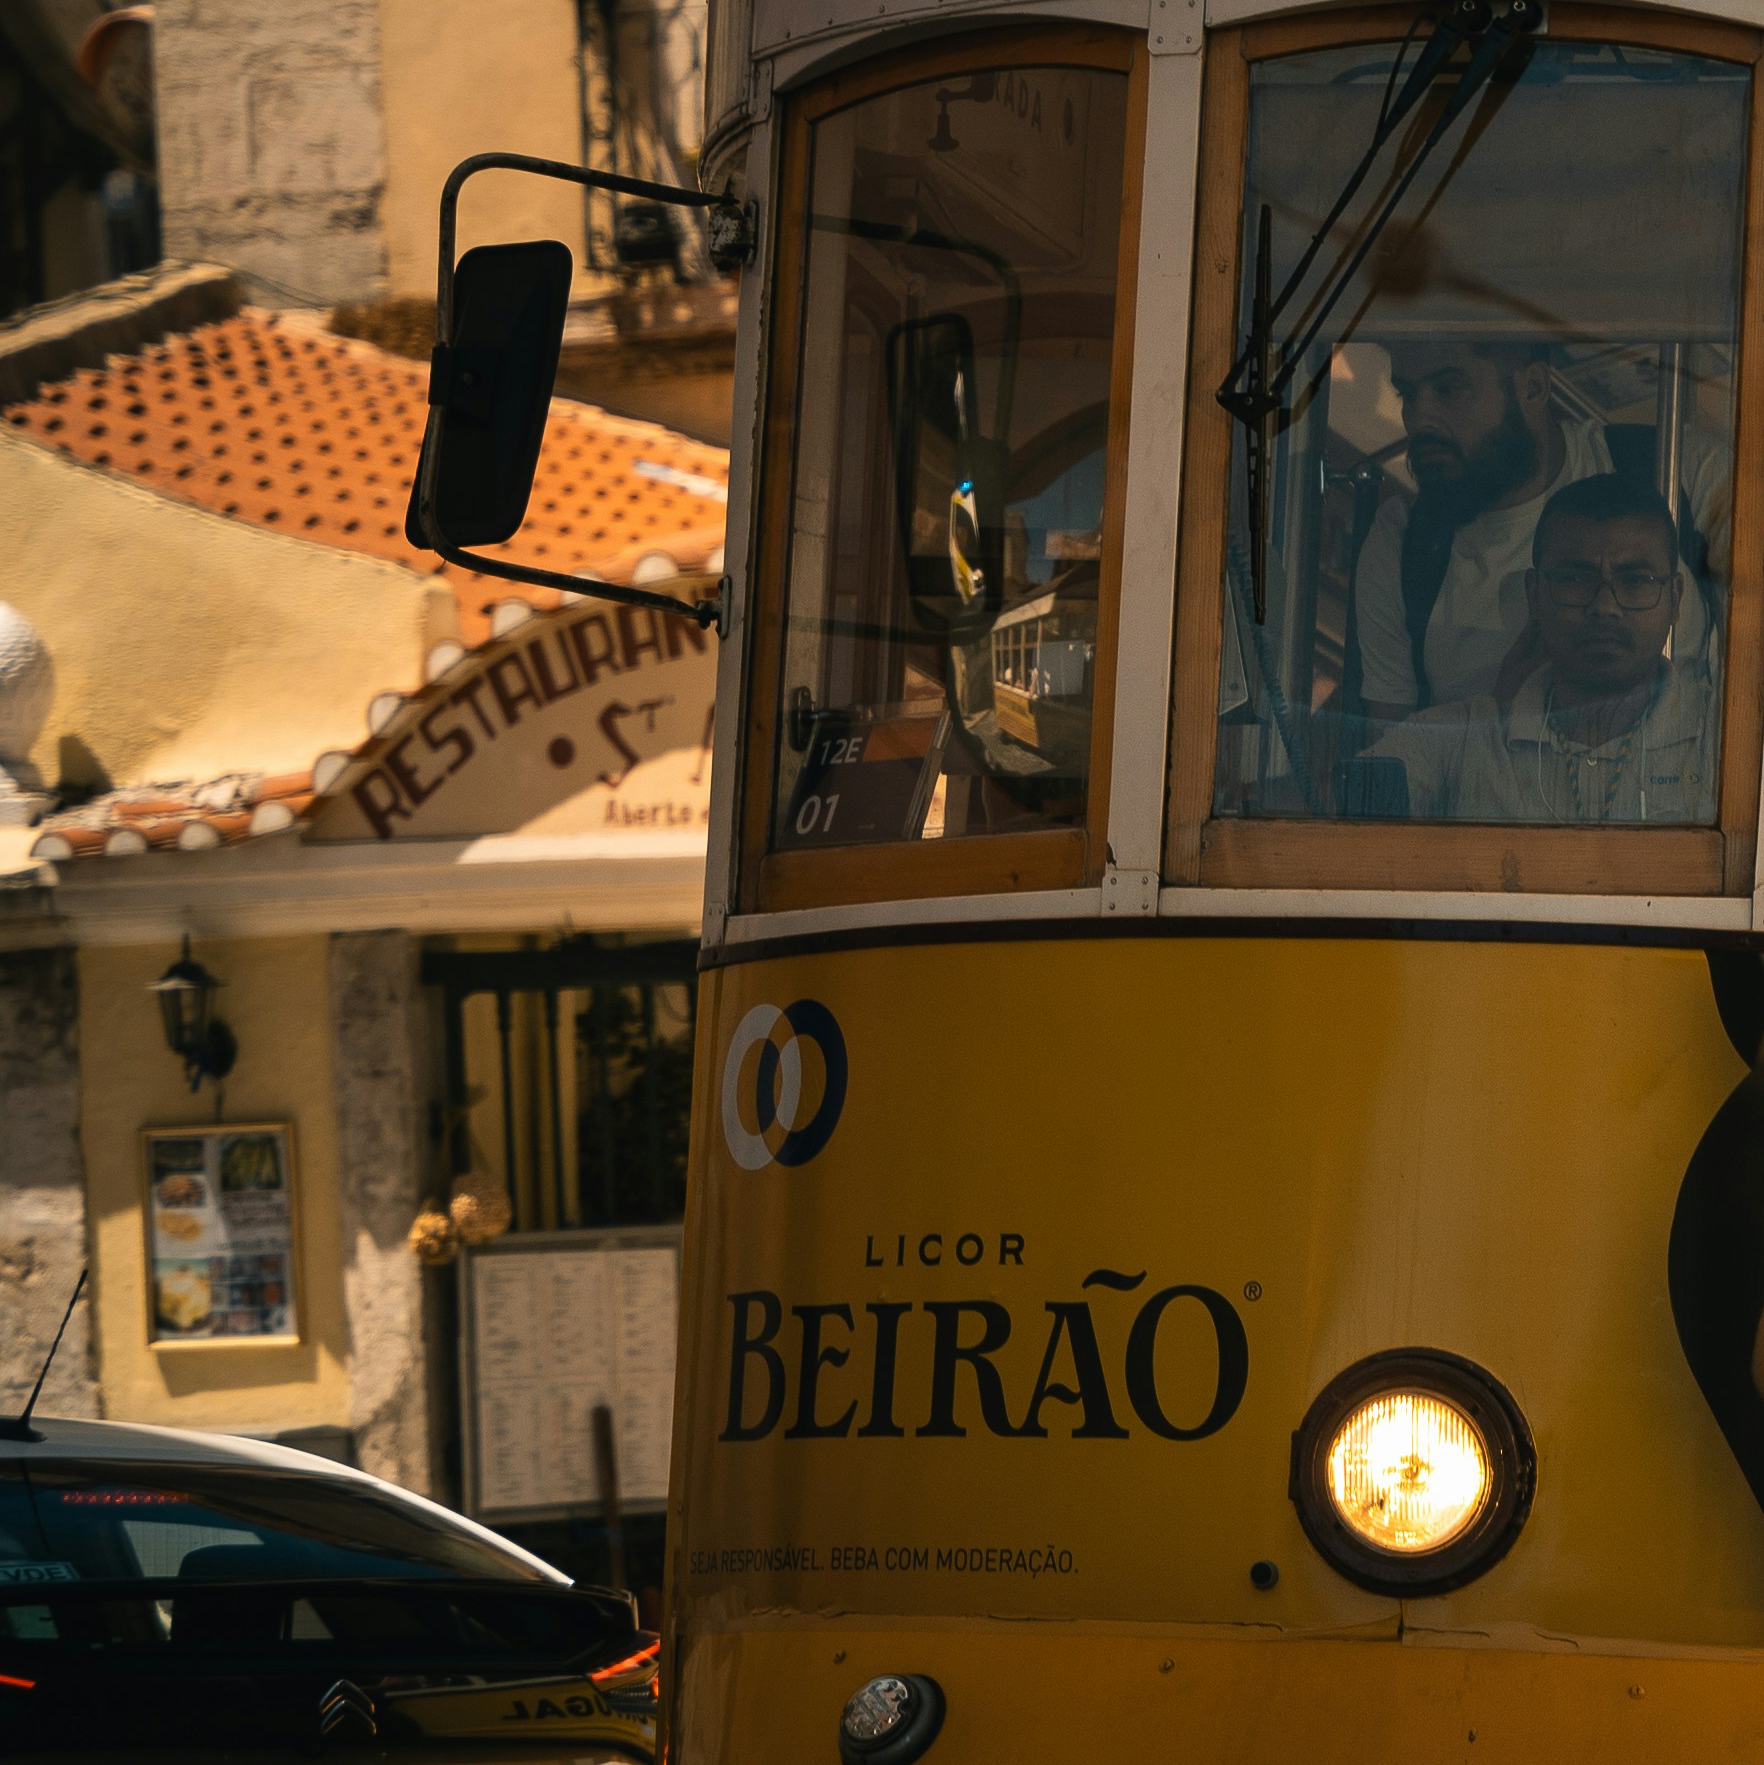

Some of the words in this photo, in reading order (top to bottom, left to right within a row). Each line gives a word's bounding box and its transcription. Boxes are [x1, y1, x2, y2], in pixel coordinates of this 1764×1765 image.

[352, 585, 719, 840] RESTAURAN
[820, 737, 863, 766] 12E
[795, 794, 841, 835] 01
[865, 1233, 1027, 1269] LICOR
[718, 1268, 1250, 1443] BEIRÃO
[0, 1565, 67, 1582] VDE
[690, 1548, 719, 1576] SEJA
[720, 1541, 825, 1574] RESPONSÁVEL.
[830, 1546, 880, 1571] BEBA
[885, 1546, 929, 1572] COM
[935, 1543, 1080, 1579] MODERAÇÃO.
